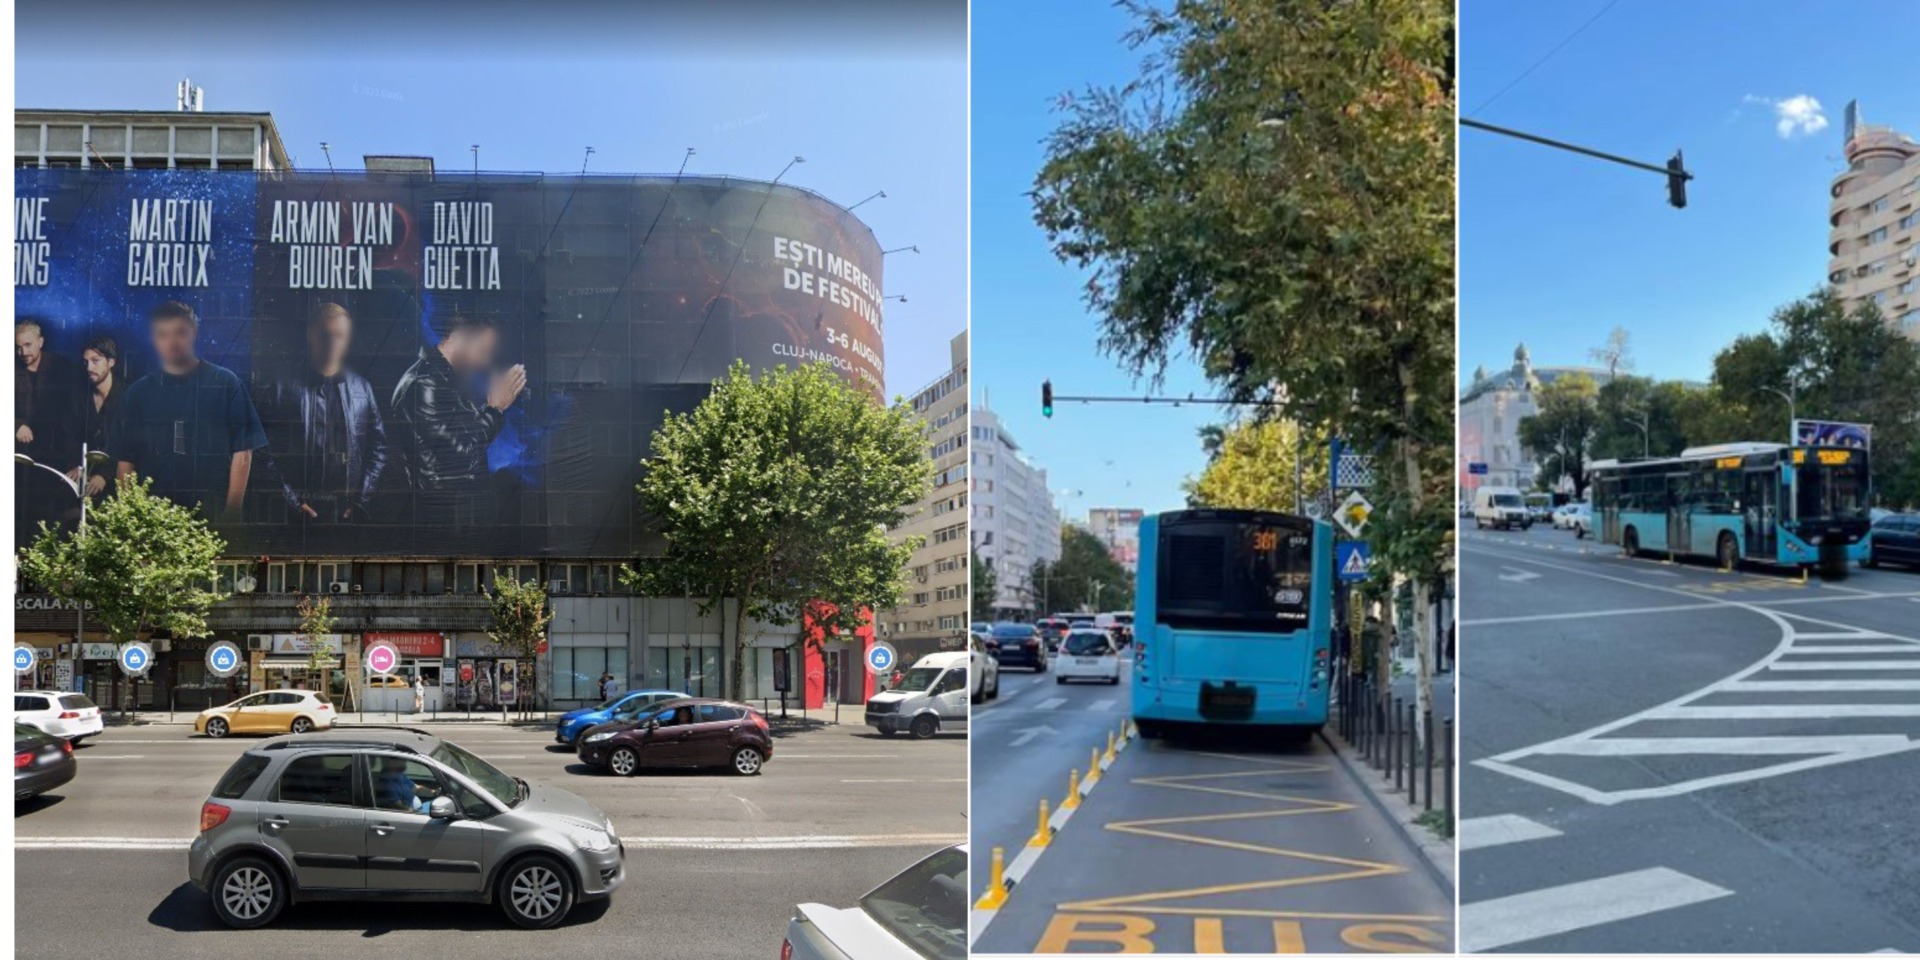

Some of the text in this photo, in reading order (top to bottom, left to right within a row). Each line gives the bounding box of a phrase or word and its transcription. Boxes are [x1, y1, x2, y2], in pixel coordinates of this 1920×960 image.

[129, 198, 212, 243] MARTIN
[270, 200, 394, 246] ARMIN VAN
[433, 201, 494, 245] DAVID
[127, 243, 210, 288] GARRIX
[288, 245, 374, 290] BUUREN
[423, 246, 502, 290] GUETTA
[774, 236, 823, 269] EȘTI
[828, 253, 876, 303] MEREU
[784, 268, 814, 295] DE
[818, 276, 882, 335] FESTIVAL
[772, 343, 854, 373] CLUJ-NAPOCA
[826, 327, 849, 349] 3-6
[16, 598, 62, 610] SCALA
